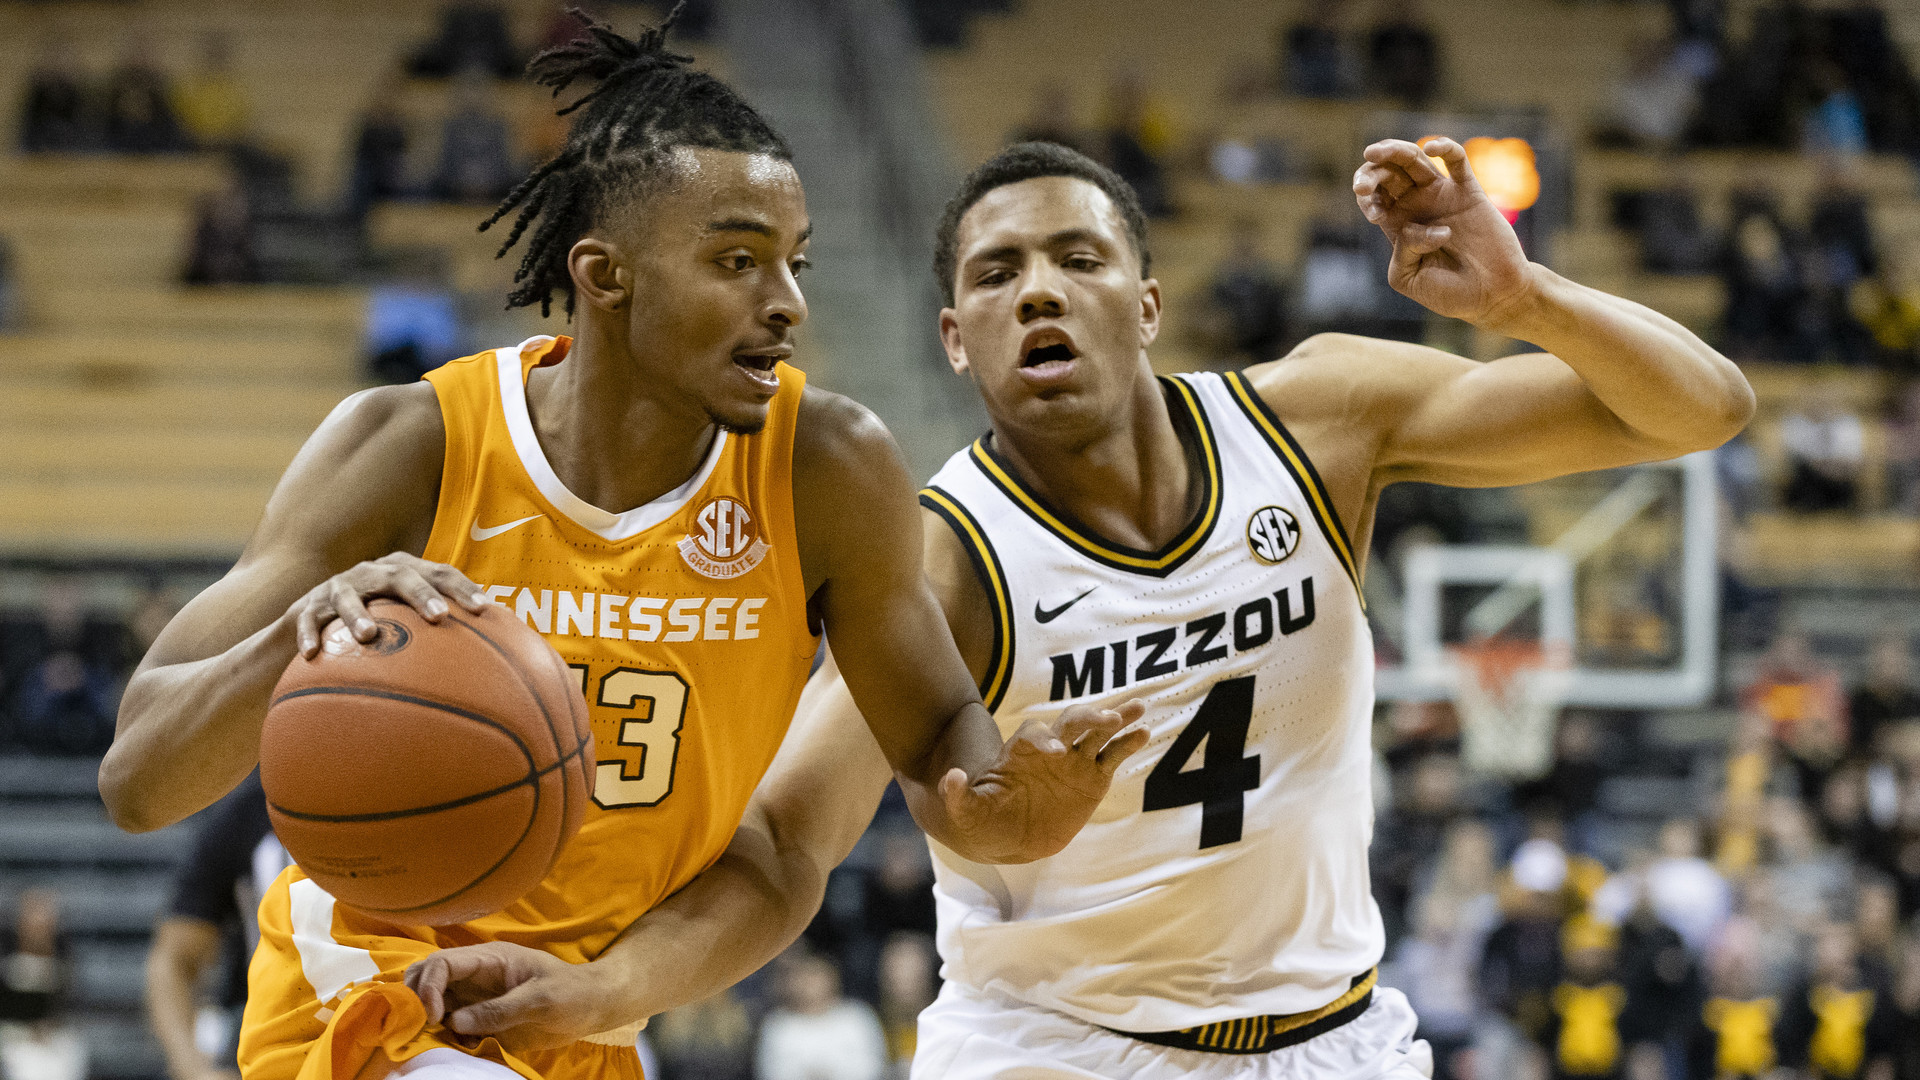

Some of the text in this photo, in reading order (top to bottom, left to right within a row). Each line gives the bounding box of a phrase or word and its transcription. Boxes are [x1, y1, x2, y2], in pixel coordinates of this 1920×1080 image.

[697, 499, 751, 558] SEC
[1249, 506, 1299, 562] SEC
[688, 552, 757, 577] GRADUATE
[476, 583, 768, 642] ENNESSEE
[1050, 576, 1316, 702] MIZZOU
[566, 663, 690, 811] 3
[1142, 674, 1261, 850] 4
